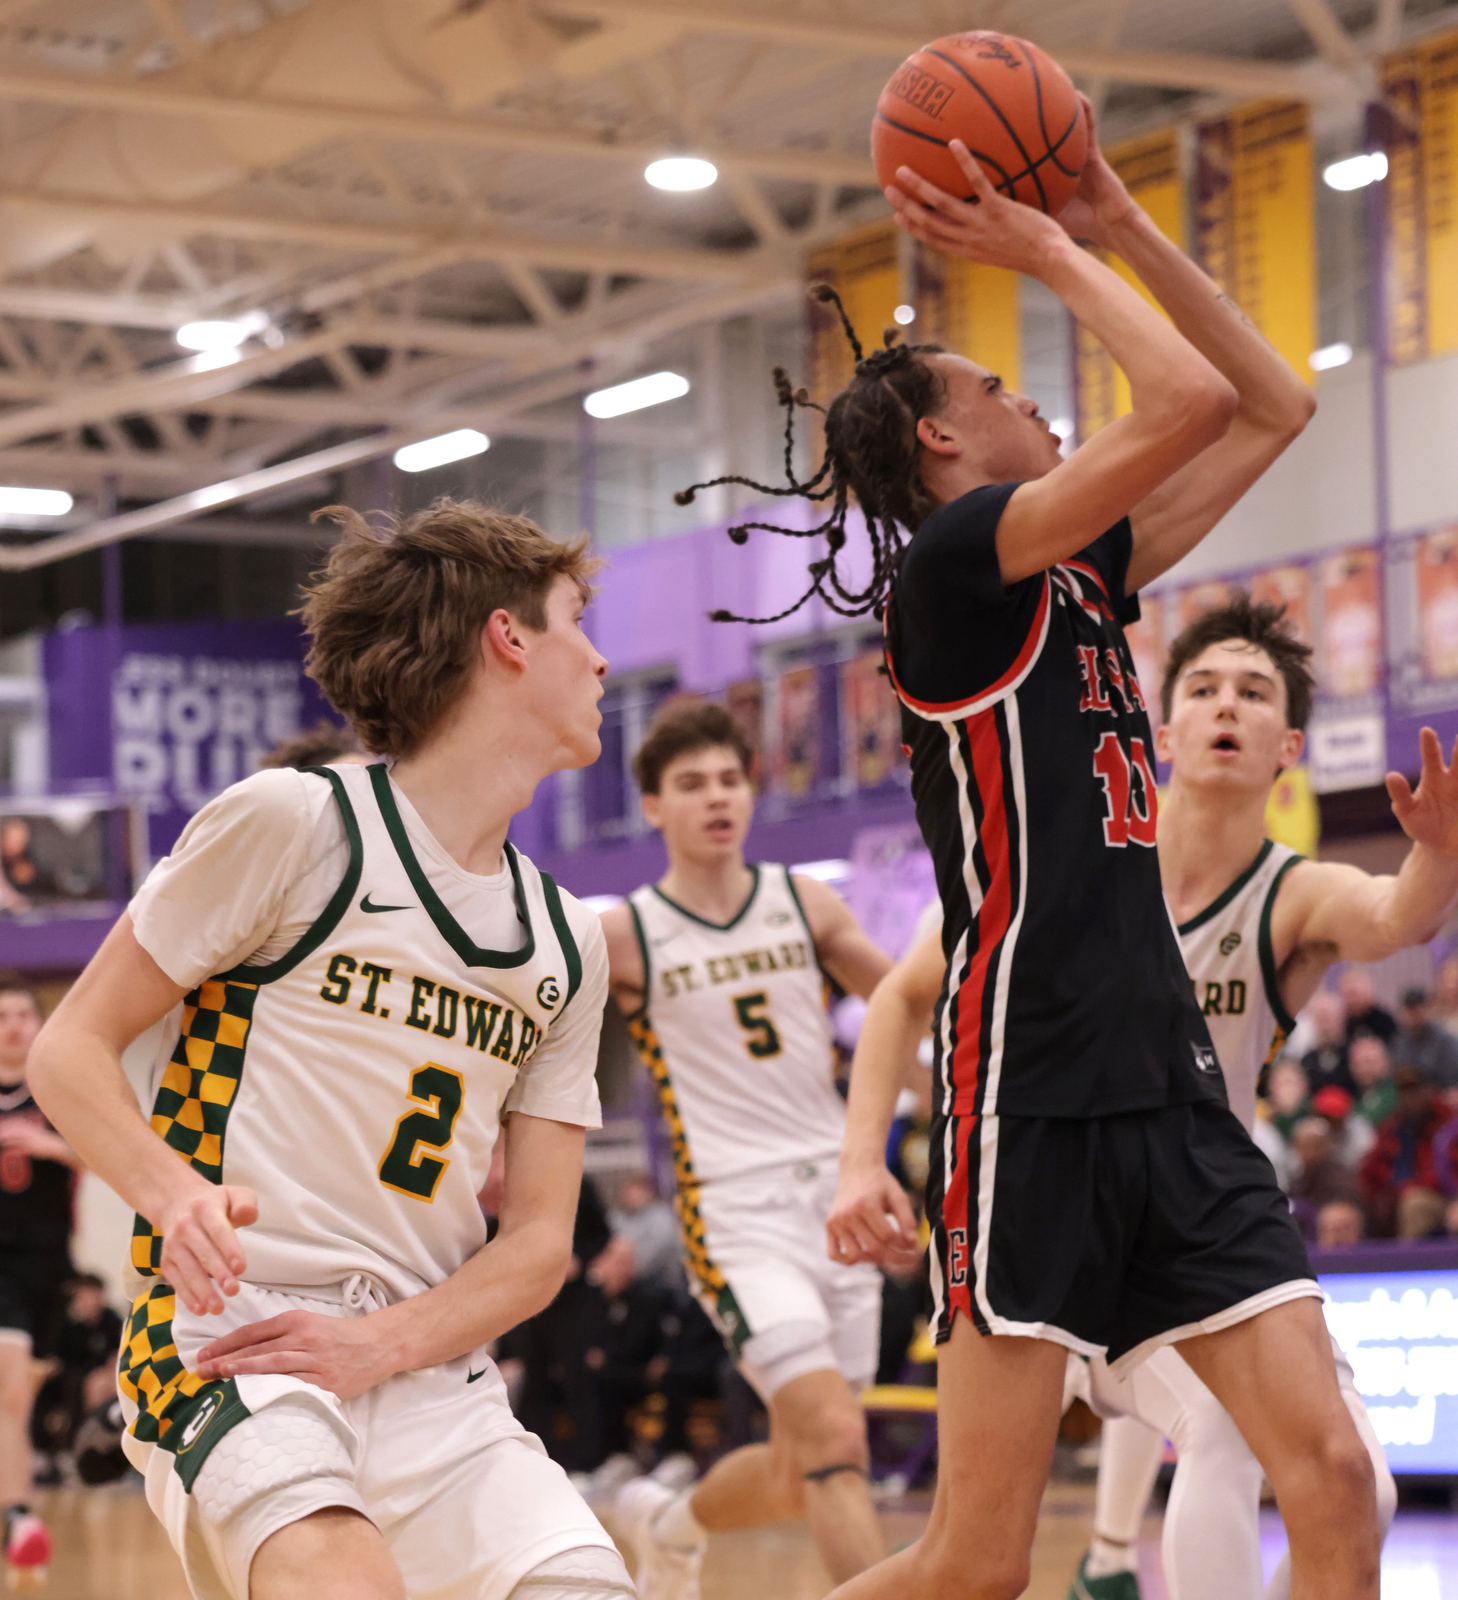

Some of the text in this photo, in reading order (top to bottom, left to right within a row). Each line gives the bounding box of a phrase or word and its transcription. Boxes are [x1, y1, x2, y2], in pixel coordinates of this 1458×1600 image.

[1093, 731, 1158, 848] 10
[319, 954, 542, 1070] ST. EDWAR
[731, 990, 783, 1061] 5
[377, 1061, 466, 1204] 2
[947, 1227, 967, 1288] E
